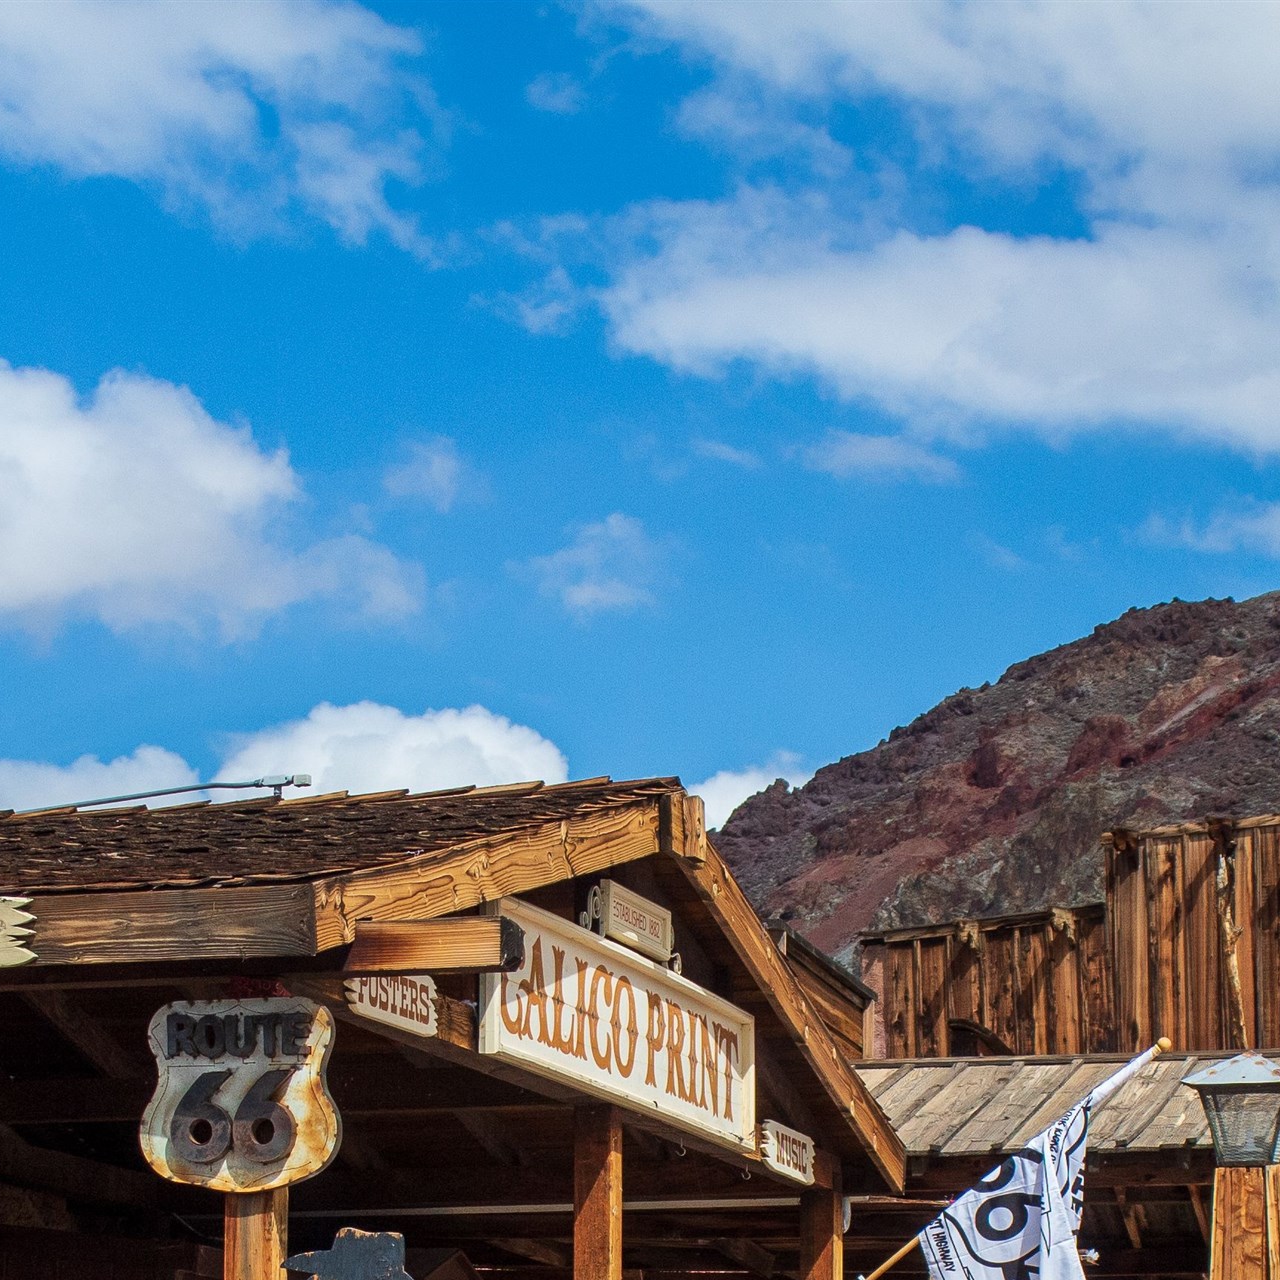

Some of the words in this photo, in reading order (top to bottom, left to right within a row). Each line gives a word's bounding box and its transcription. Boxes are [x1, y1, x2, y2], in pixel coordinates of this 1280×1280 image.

[358, 975, 430, 1025] POSTERS
[166, 1011, 313, 1060] ROUTE
[500, 934, 638, 1079] CALICO
[645, 988, 739, 1123] PRINT
[170, 1067, 298, 1165] 66
[775, 1130, 808, 1175] MUSIC
[931, 1231, 956, 1272] HIGHWAY
